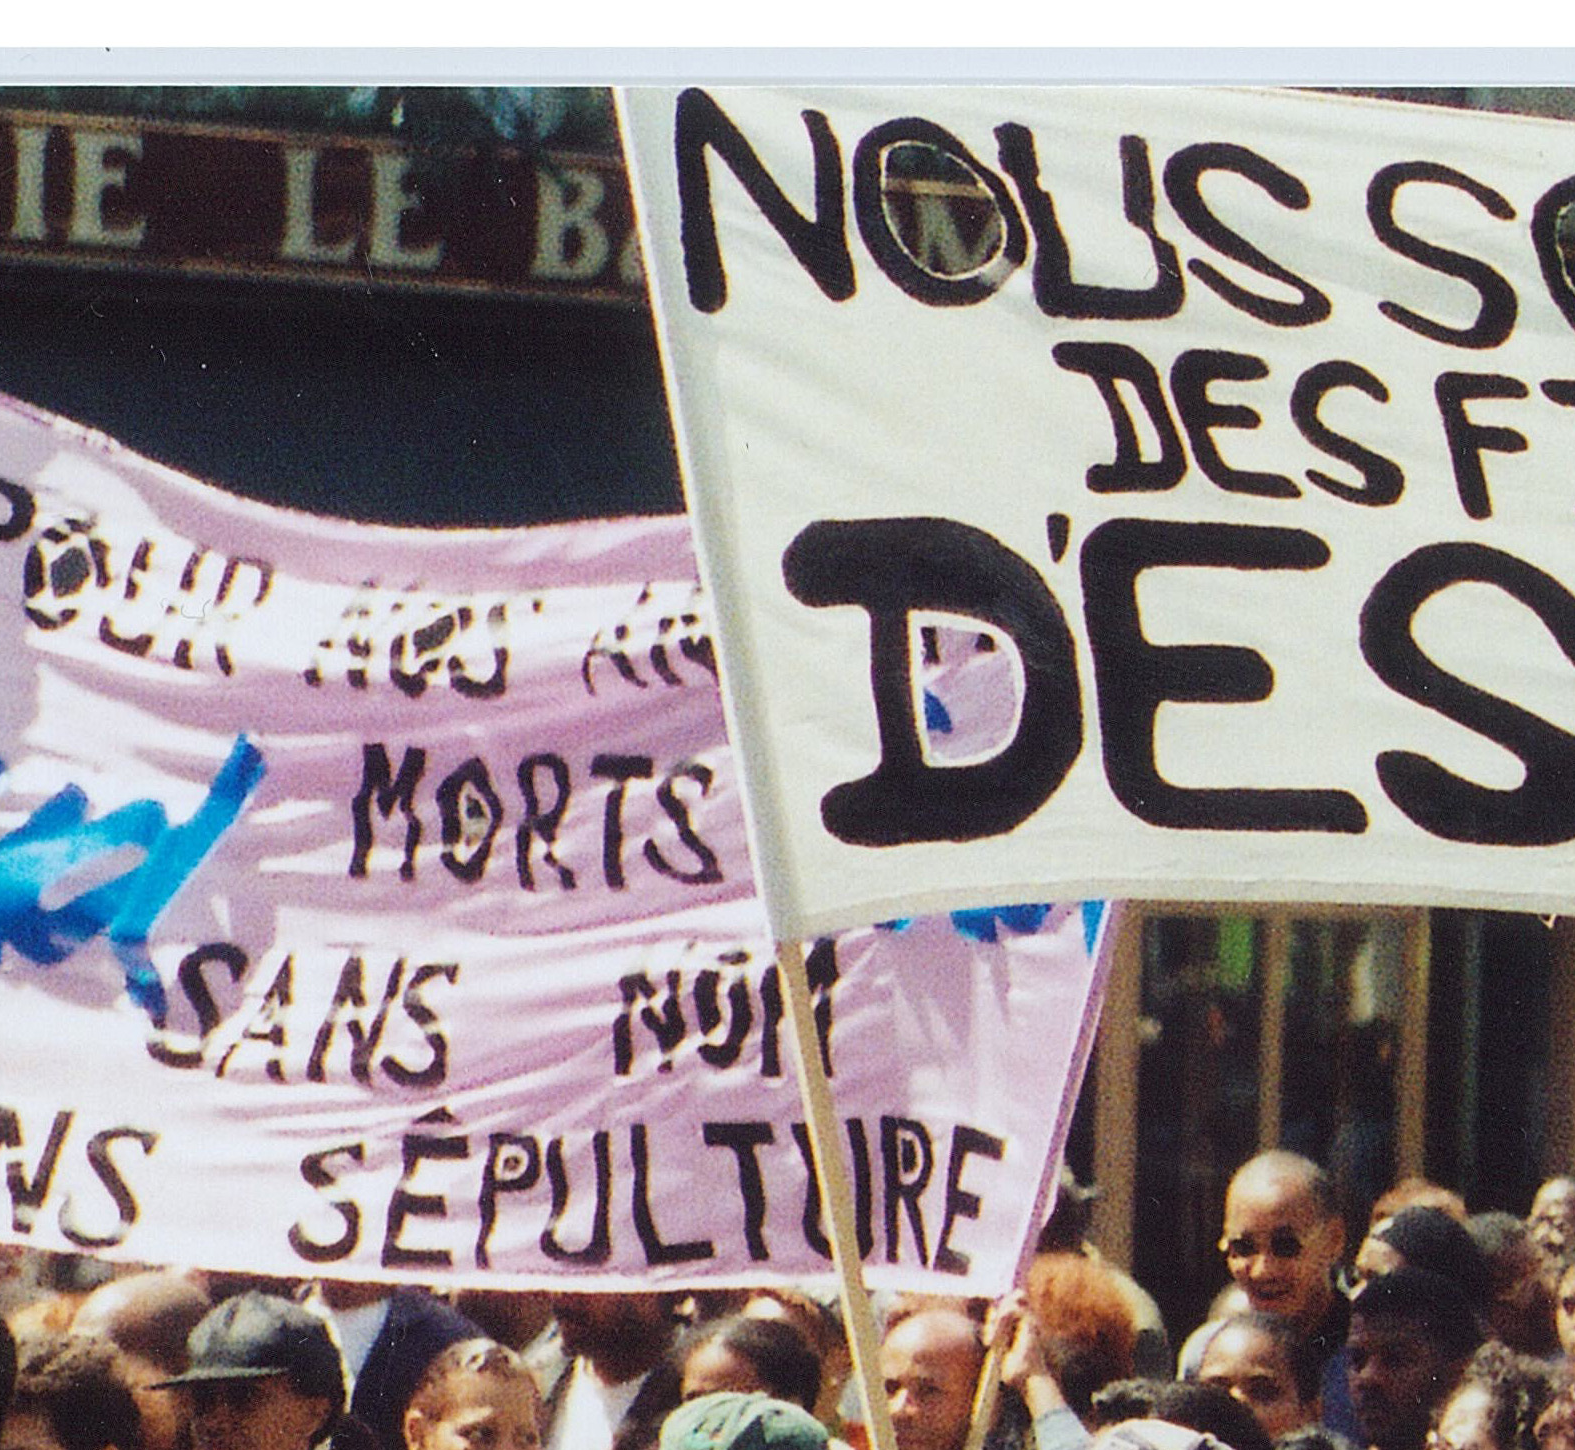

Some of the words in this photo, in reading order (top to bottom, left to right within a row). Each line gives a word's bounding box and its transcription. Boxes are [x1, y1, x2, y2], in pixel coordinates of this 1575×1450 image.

[277, 148, 443, 271] LE
[674, 87, 1334, 326] NOUS
[1053, 341, 1406, 507] DES
[347, 742, 725, 892] MORTS
[145, 940, 459, 1088] SANS
[612, 935, 842, 1080] NOM
